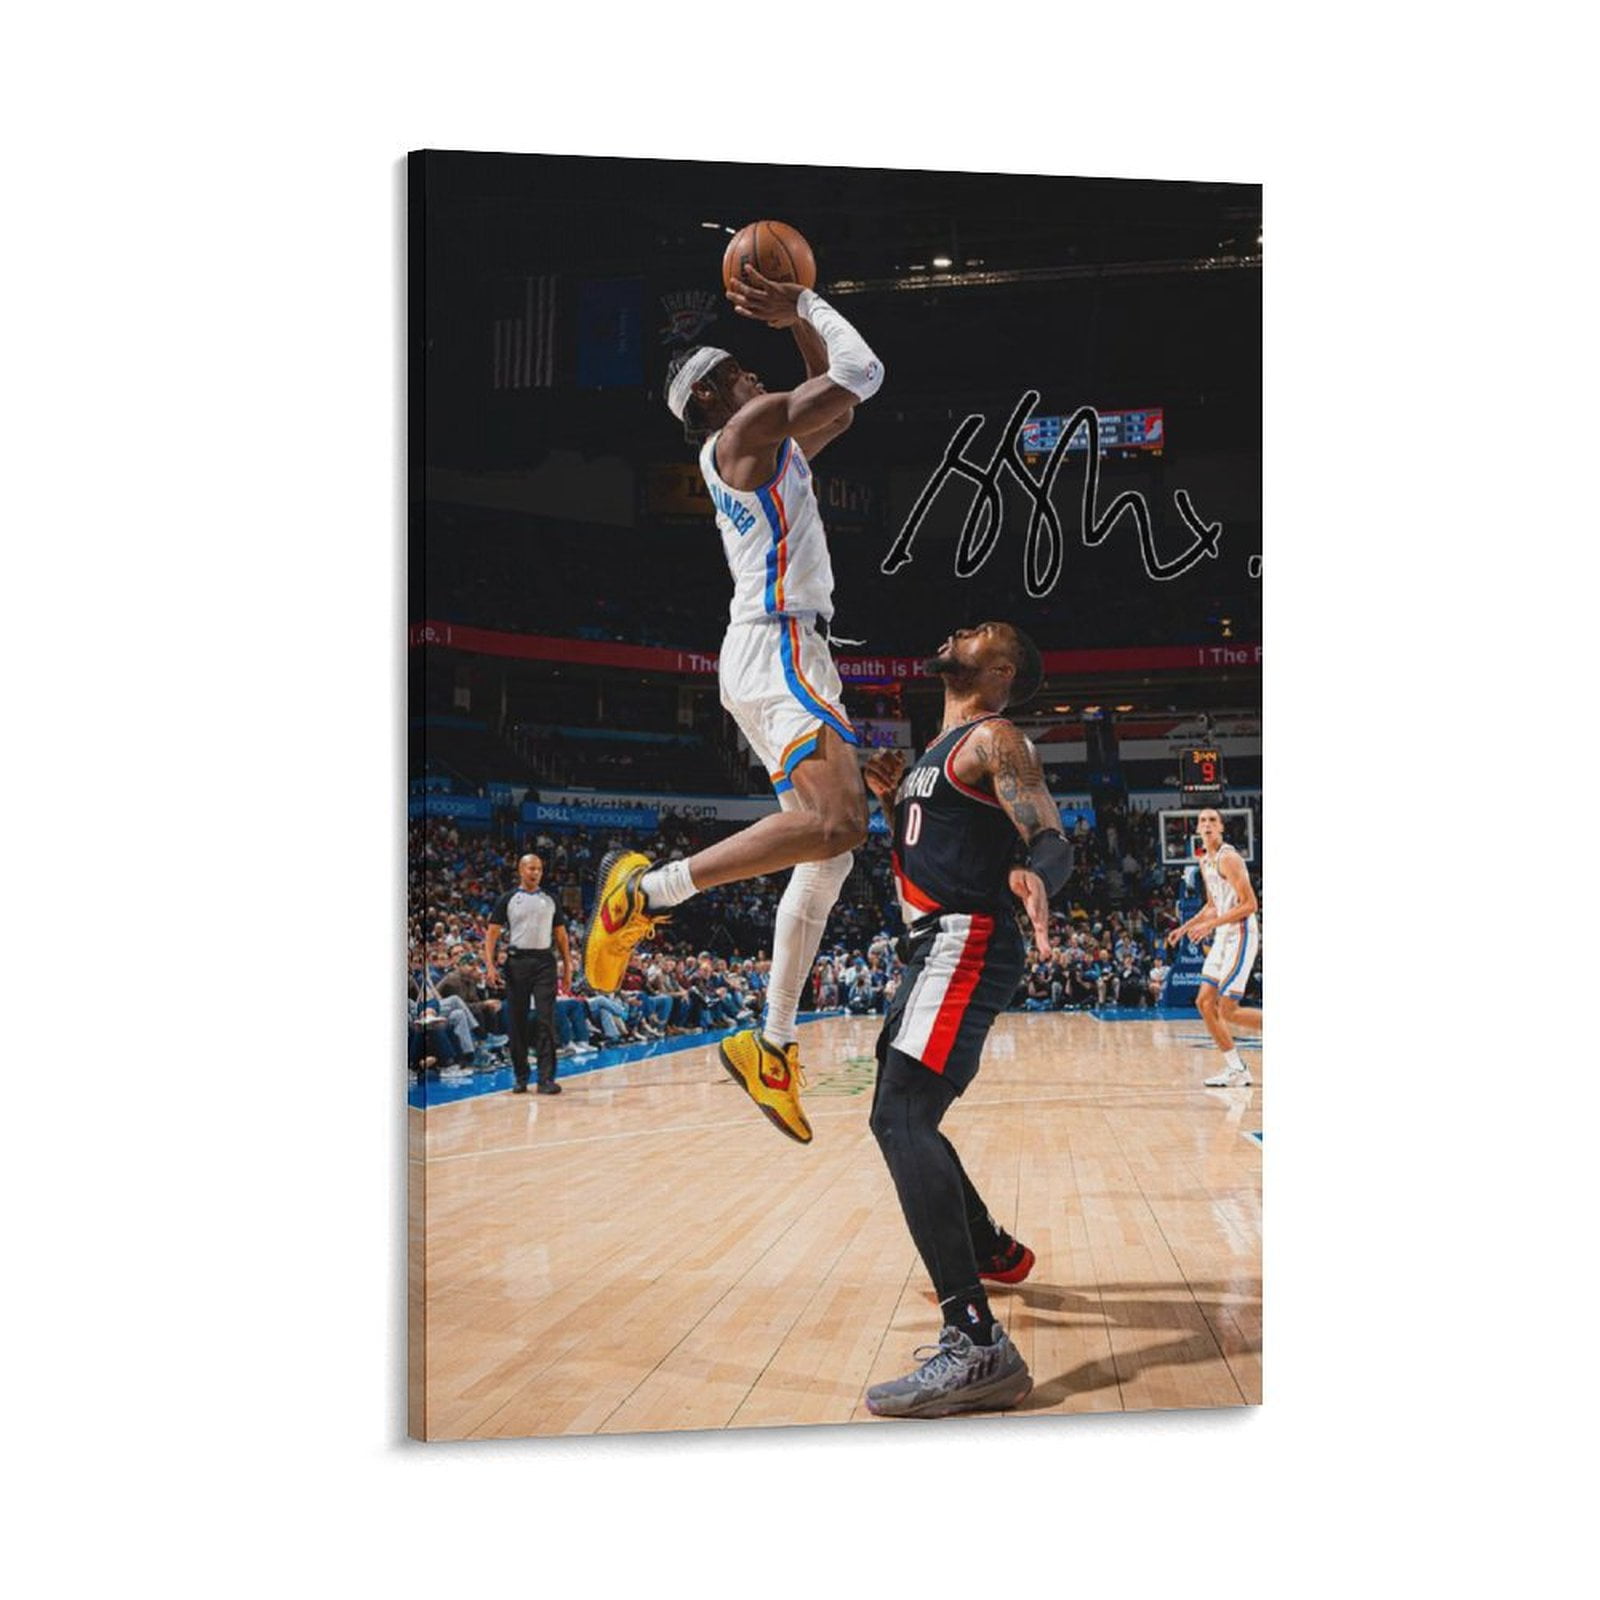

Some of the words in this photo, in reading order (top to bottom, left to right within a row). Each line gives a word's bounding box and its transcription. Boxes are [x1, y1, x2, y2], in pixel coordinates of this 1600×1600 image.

[1209, 647, 1249, 664] The
[892, 660, 908, 677] is
[1202, 762, 1215, 782] 9
[906, 803, 922, 846] 0
